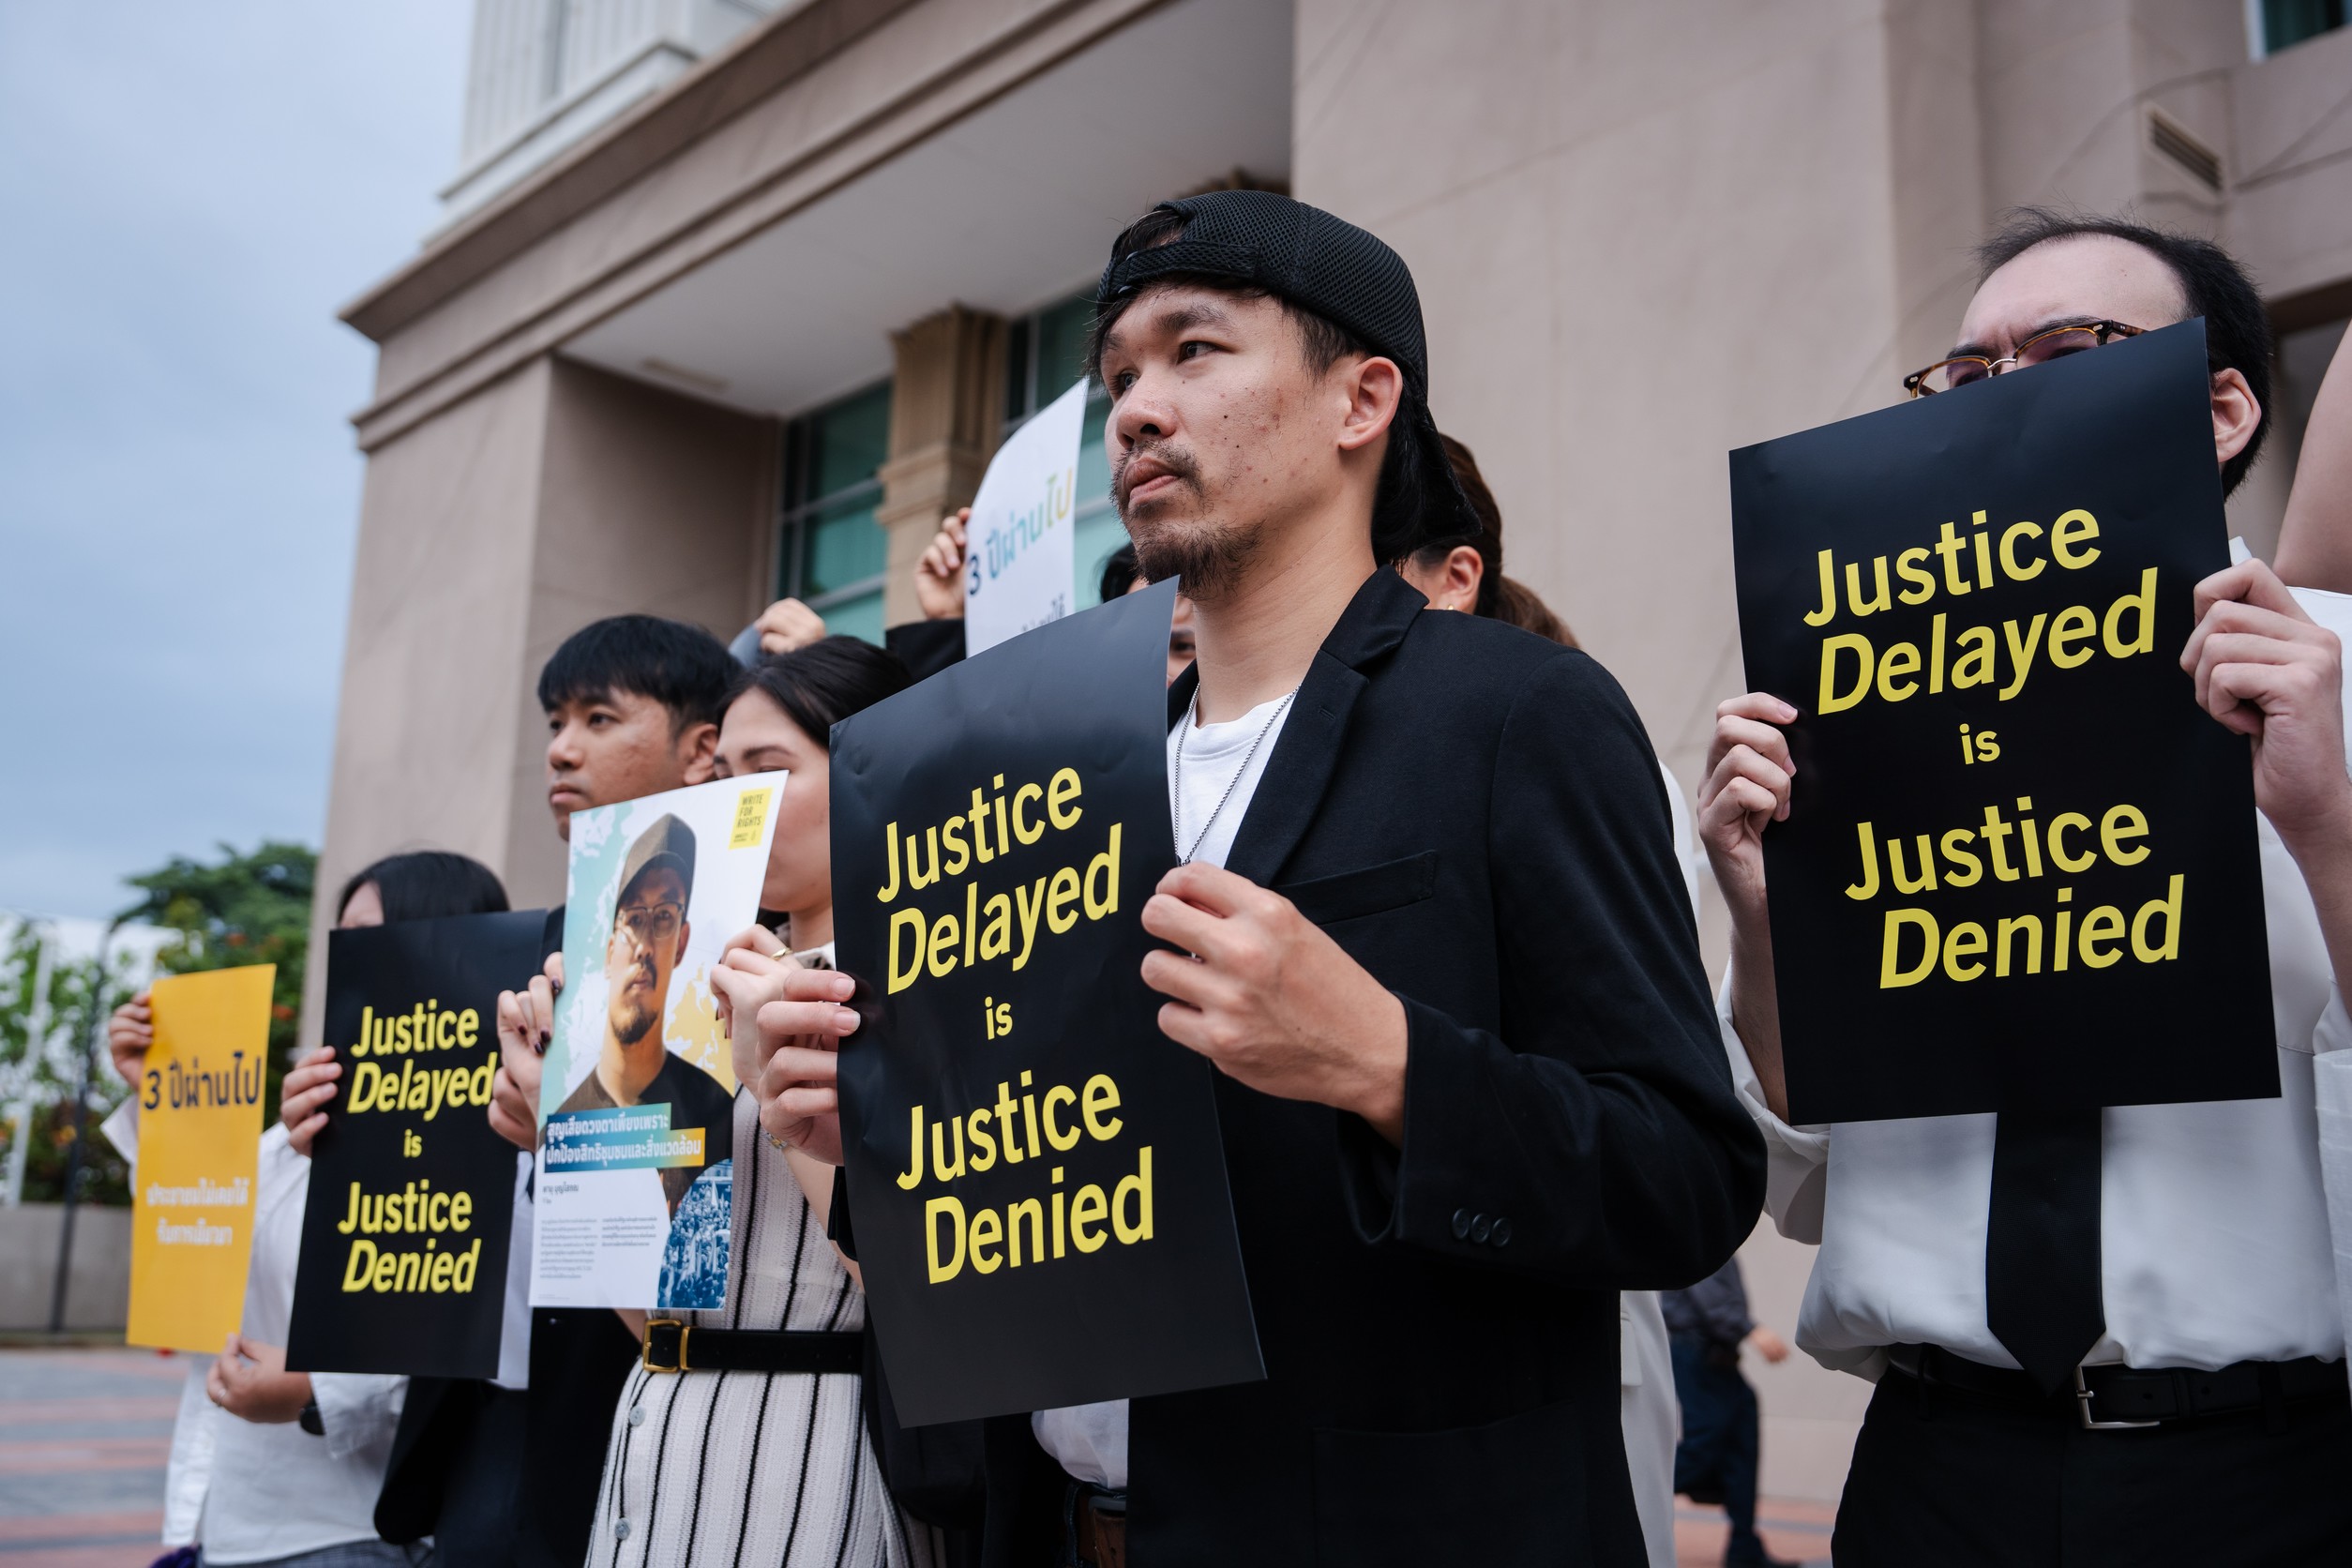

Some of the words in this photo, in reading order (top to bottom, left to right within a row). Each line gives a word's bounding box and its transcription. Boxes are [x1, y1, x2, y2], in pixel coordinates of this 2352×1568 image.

[969, 551, 981, 596] 3
[987, 466, 1073, 580] ปีผ่านไป
[1803, 509, 2102, 627] Justice
[1817, 566, 2158, 716] Delayed
[1960, 723, 2000, 765] is
[737, 816, 761, 828] RIGHTS
[739, 807, 754, 817] FOR
[742, 793, 764, 806] WRITE
[878, 767, 1083, 903] Justice
[1845, 795, 2151, 901] Justice
[888, 822, 1123, 995] Delayed
[1879, 873, 2184, 989] Denied
[350, 998, 479, 1058] Justice
[984, 996, 1013, 1041] is
[144, 1069, 161, 1110] 3
[169, 1050, 262, 1109] ปีผ่านไป
[346, 1051, 498, 1122] Delayed
[403, 1128, 422, 1158] is
[546, 1134, 701, 1167] ปกป้องสิทธิชุมชนและสิ่งแวดล้อม
[547, 1112, 669, 1144] สูญเสียดวงตาเพียงเพราะ
[897, 1070, 1123, 1190] Justice
[338, 1178, 473, 1234] Justice
[926, 1145, 1153, 1285] Denied
[341, 1238, 482, 1293] Denied
